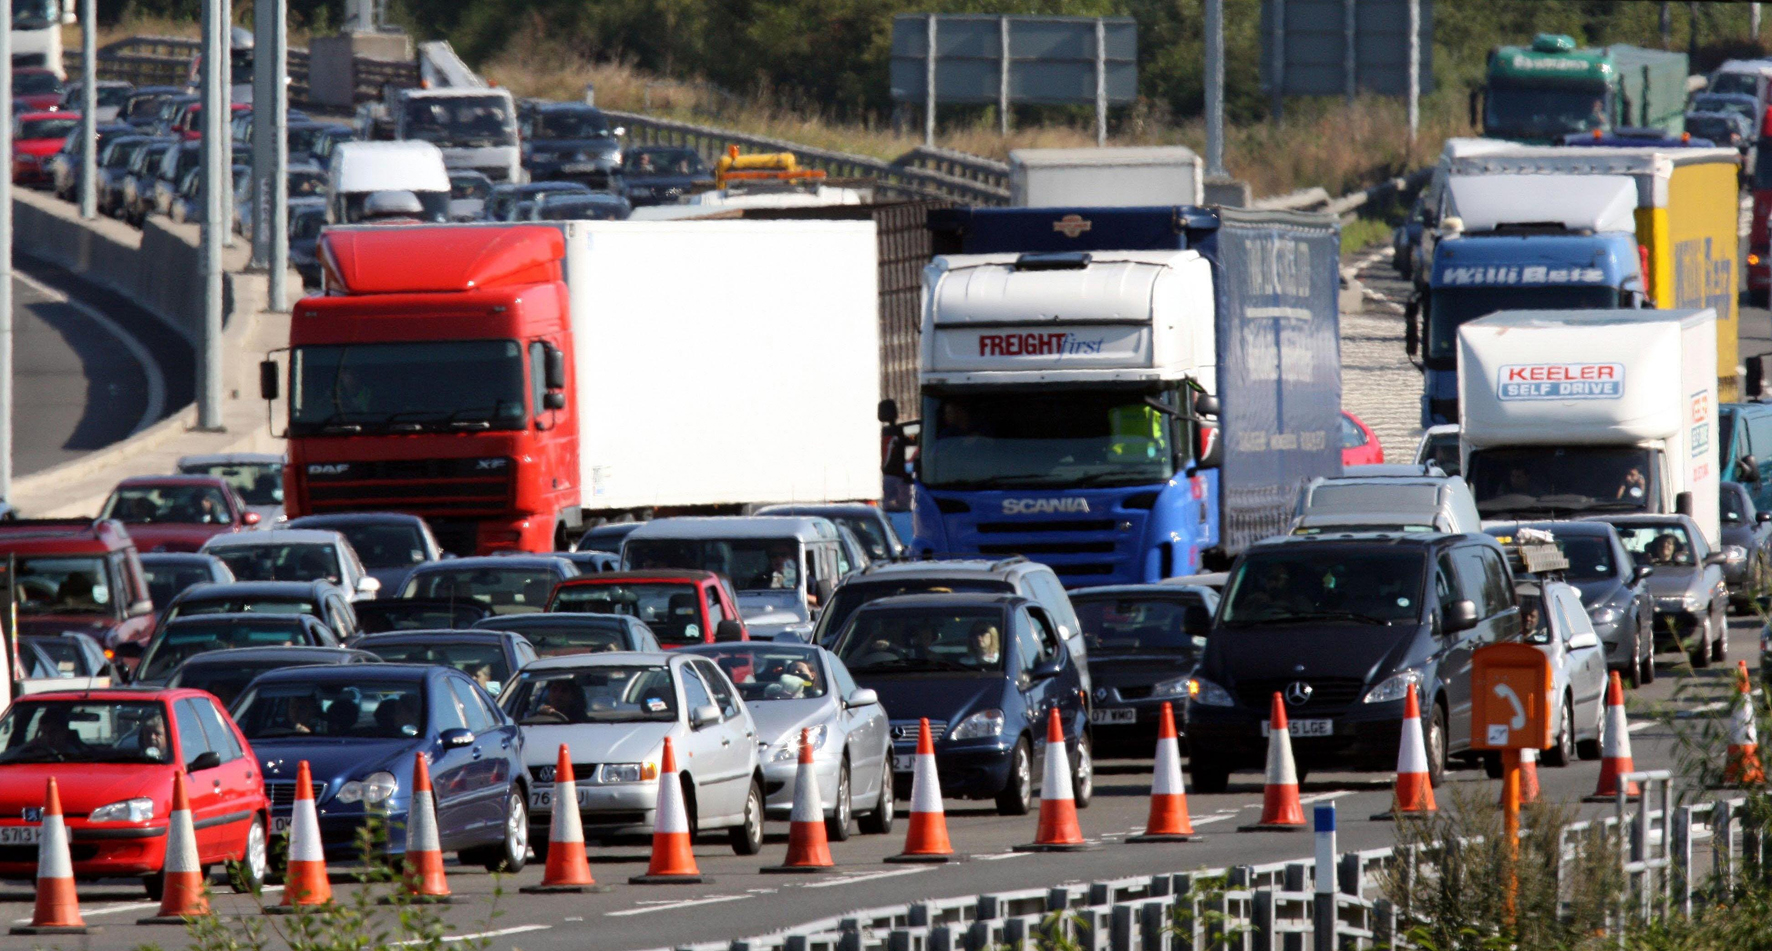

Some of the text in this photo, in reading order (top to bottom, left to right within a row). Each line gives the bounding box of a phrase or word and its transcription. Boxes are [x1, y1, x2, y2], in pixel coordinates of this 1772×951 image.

[1443, 266, 1519, 285] Willi
[1508, 365, 1614, 381] KEELER
[1507, 382, 1614, 396] SELF DRIVE
[308, 463, 349, 475] DAF
[475, 458, 507, 470] XF
[1002, 497, 1090, 515] SCANIA
